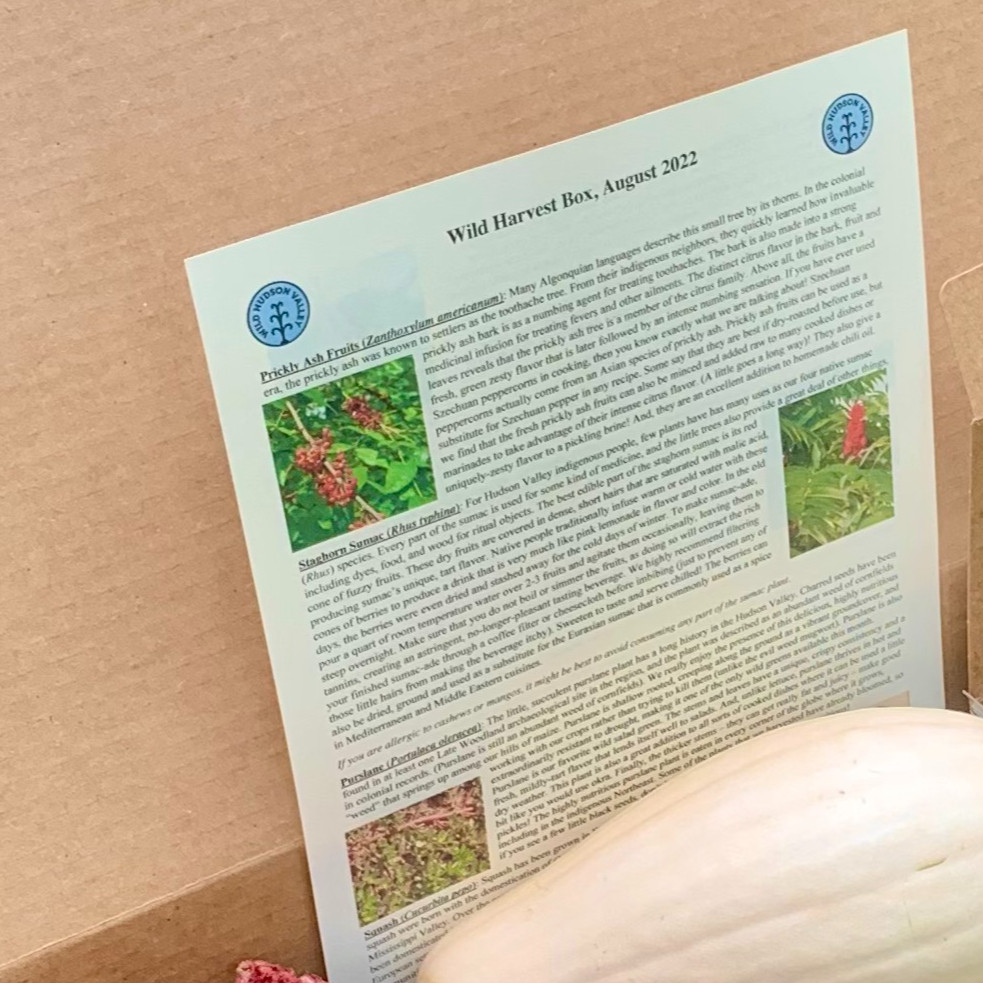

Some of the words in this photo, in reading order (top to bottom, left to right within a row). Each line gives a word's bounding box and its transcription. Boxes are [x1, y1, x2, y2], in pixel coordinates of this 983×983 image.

[446, 218, 489, 244] Wild
[491, 198, 557, 231] Harvest
[560, 190, 598, 208] Box,
[603, 164, 657, 195] August
[661, 149, 698, 175] 2022
[252, 314, 269, 339] WILD
[253, 286, 291, 312] HUDSON
[259, 361, 301, 384] Prickly
[303, 352, 326, 371] Ash
[325, 342, 361, 363] Fruits
[361, 316, 436, 351] (Zanthoxylum
[436, 291, 506, 326] americanum):
[508, 282, 536, 297] Many
[539, 262, 594, 288] Algonquian
[594, 246, 642, 268] languages
[642, 232, 681, 252] describe
[681, 224, 699, 238] this
[700, 213, 726, 232] small
[726, 210, 744, 222] tree
[745, 205, 757, 216] by
[758, 200, 770, 211] its
[803, 185, 814, 195] In
[814, 180, 829, 191] the
[829, 165, 865, 186] colonial
[262, 385, 283, 398] era,
[283, 378, 301, 390] the
[302, 364, 339, 387] prickly
[341, 356, 359, 371] ash
[360, 351, 381, 363] was
[381, 338, 418, 357] known
[418, 334, 430, 345] to
[431, 322, 467, 340] settlers
[468, 317, 479, 328] as
[480, 311, 496, 324] the
[497, 295, 544, 318] toothache
[568, 277, 595, 293] From
[595, 268, 618, 284] their
[619, 252, 670, 275] indigenous
[718, 228, 738, 240] they
[739, 214, 773, 235] quickly
[774, 200, 807, 221] learned
[807, 196, 828, 209] how
[828, 179, 875, 202] invaluable
[291, 291, 305, 328] VALLEY
[431, 397, 479, 420] Szechuan
[479, 376, 538, 406] peppercorns
[539, 372, 550, 382] in
[550, 358, 591, 378] cooking,
[591, 349, 613, 363] then
[614, 342, 633, 357] you
[632, 333, 658, 348] know
[660, 320, 693, 338] exactly
[693, 311, 717, 325] what
[717, 306, 731, 317] we
[297, 546, 349, 572] Staghorn
[348, 532, 386, 554] Sumac
[385, 520, 418, 541] (Rhus
[418, 502, 461, 529] typhina):
[464, 495, 482, 508] For
[483, 481, 520, 501] Hudson
[521, 469, 552, 486] Valley
[554, 450, 604, 475] indigenous
[639, 431, 656, 443] few
[657, 420, 685, 438] plants
[685, 411, 707, 425] have
[708, 405, 724, 416] has
[725, 395, 749, 410] many
[306, 598, 331, 613] cone
[332, 590, 344, 603] of
[345, 582, 373, 598] fuzzy
[374, 571, 404, 587] fruits.
[404, 559, 434, 575] These
[435, 552, 452, 564] dry
[453, 542, 480, 557] fruits
[480, 535, 496, 547] are
[497, 518, 535, 540] covered
[535, 516, 546, 526] in
[577, 494, 601, 510] short
[601, 486, 625, 501] hairs
[625, 478, 643, 492] that
[644, 473, 659, 484] are
[659, 455, 700, 478] saturated
[700, 447, 721, 462] with
[721, 439, 746, 454] malic
[322, 677, 361, 696] tannins,
[362, 659, 402, 680] creating
[402, 654, 415, 664] an
[466, 599, 551, 639] no-longer-pleasant
[551, 587, 583, 605] tasting
[627, 563, 643, 574] We
[644, 551, 672, 568] highly
[673, 528, 725, 556] recommend
[333, 740, 344, 750] in
[344, 711, 413, 745] Mediterranean
[414, 701, 432, 716] and
[433, 689, 467, 708] Middle
[468, 674, 503, 694] Eastern
[503, 659, 542, 680] cuisines.
[339, 763, 386, 789] Purslane
[385, 741, 438, 771] (Portulaca
[485, 713, 504, 725] The
[530, 684, 572, 707] succulent
[572, 669, 610, 692] purslane
[363, 917, 400, 941] Squash
[399, 894, 451, 925] (Cucurbita
